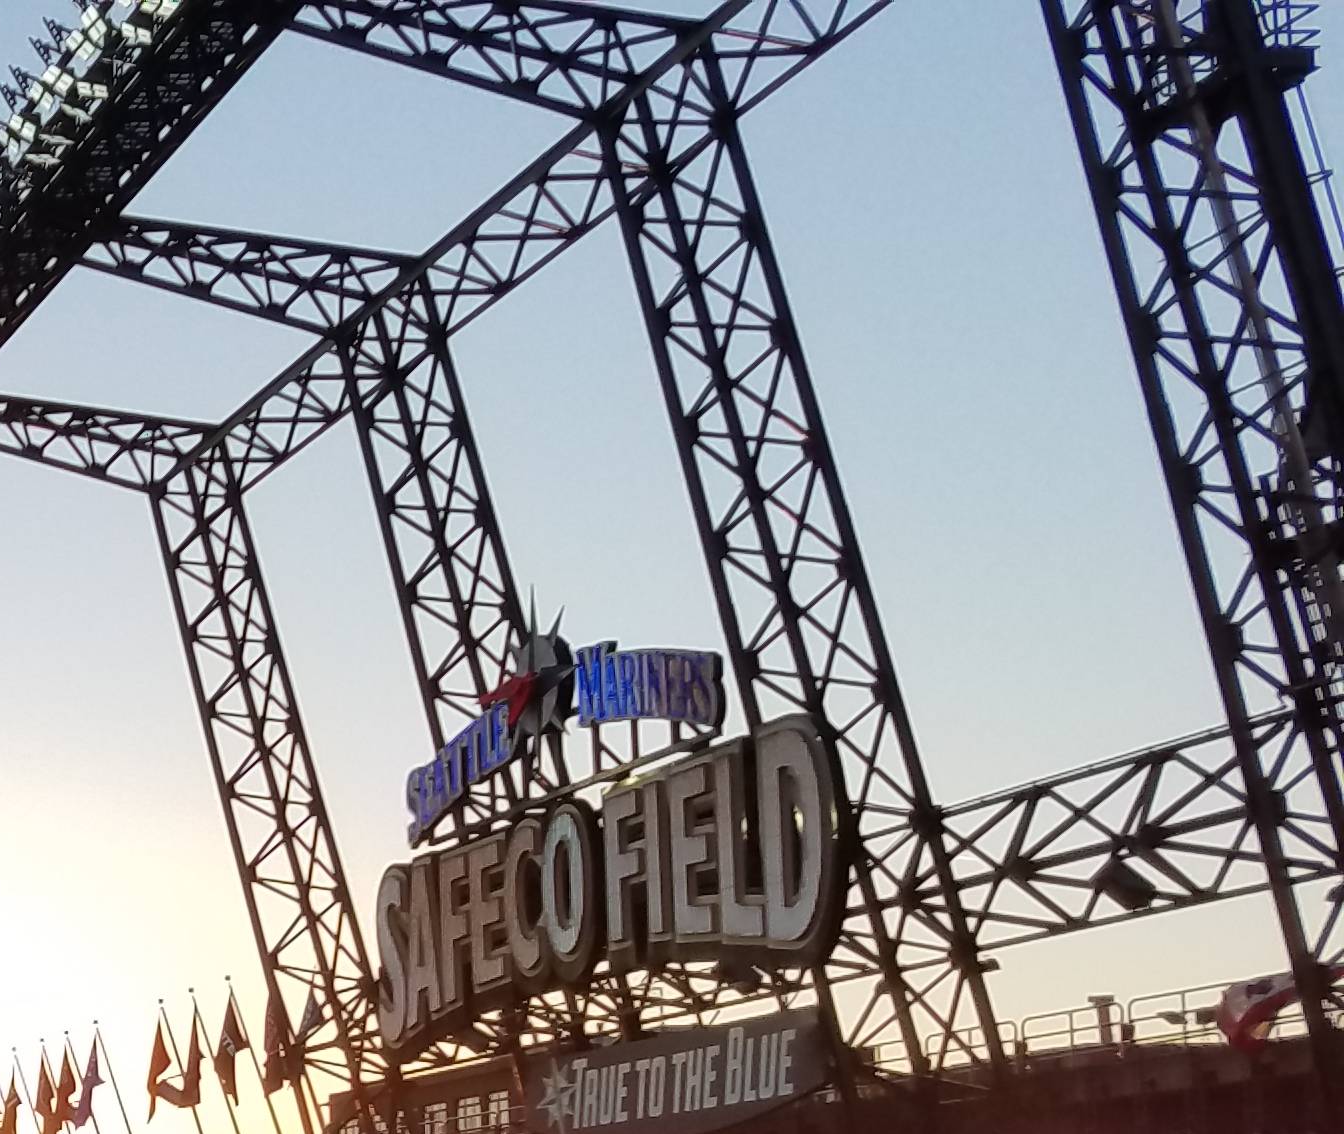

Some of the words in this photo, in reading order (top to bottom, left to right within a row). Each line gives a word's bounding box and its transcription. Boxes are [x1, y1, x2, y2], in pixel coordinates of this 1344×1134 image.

[576, 641, 723, 728] MARINERS
[408, 703, 512, 846] SEATTLE
[377, 799, 596, 1047] SAFECO
[601, 715, 842, 955] FIELD
[571, 1057, 630, 1128] TRUE
[636, 1055, 663, 1119] TO
[671, 1045, 720, 1112] THE
[725, 1026, 796, 1104] BLUE
